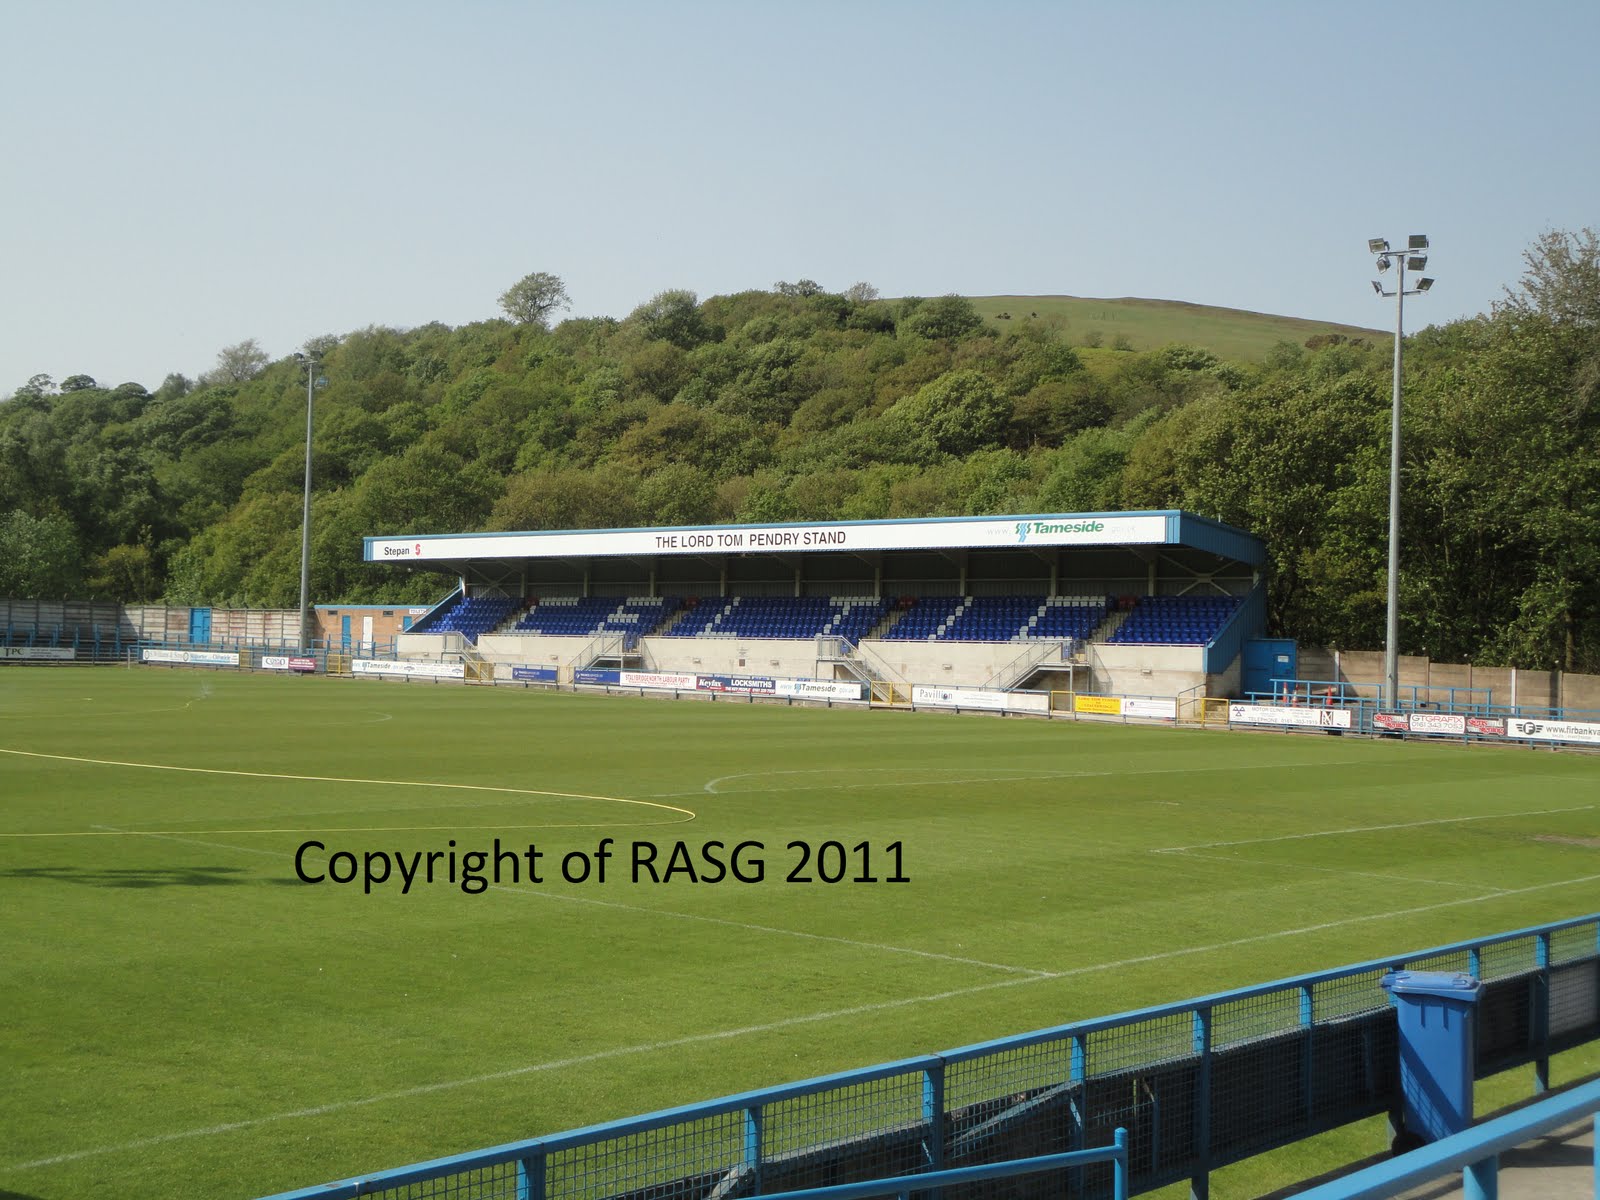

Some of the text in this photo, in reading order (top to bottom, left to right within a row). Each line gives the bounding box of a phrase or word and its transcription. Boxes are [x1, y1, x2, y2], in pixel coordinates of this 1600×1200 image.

[1033, 520, 1104, 534] Tameside
[655, 531, 847, 548] THE LORD TOM PENDRY STAND
[384, 546, 410, 557] Stepan
[367, 661, 391, 669] Tameside
[730, 679, 773, 688] LOCKSMITHS
[802, 683, 837, 693] Tameside
[919, 688, 953, 700] Pavillion
